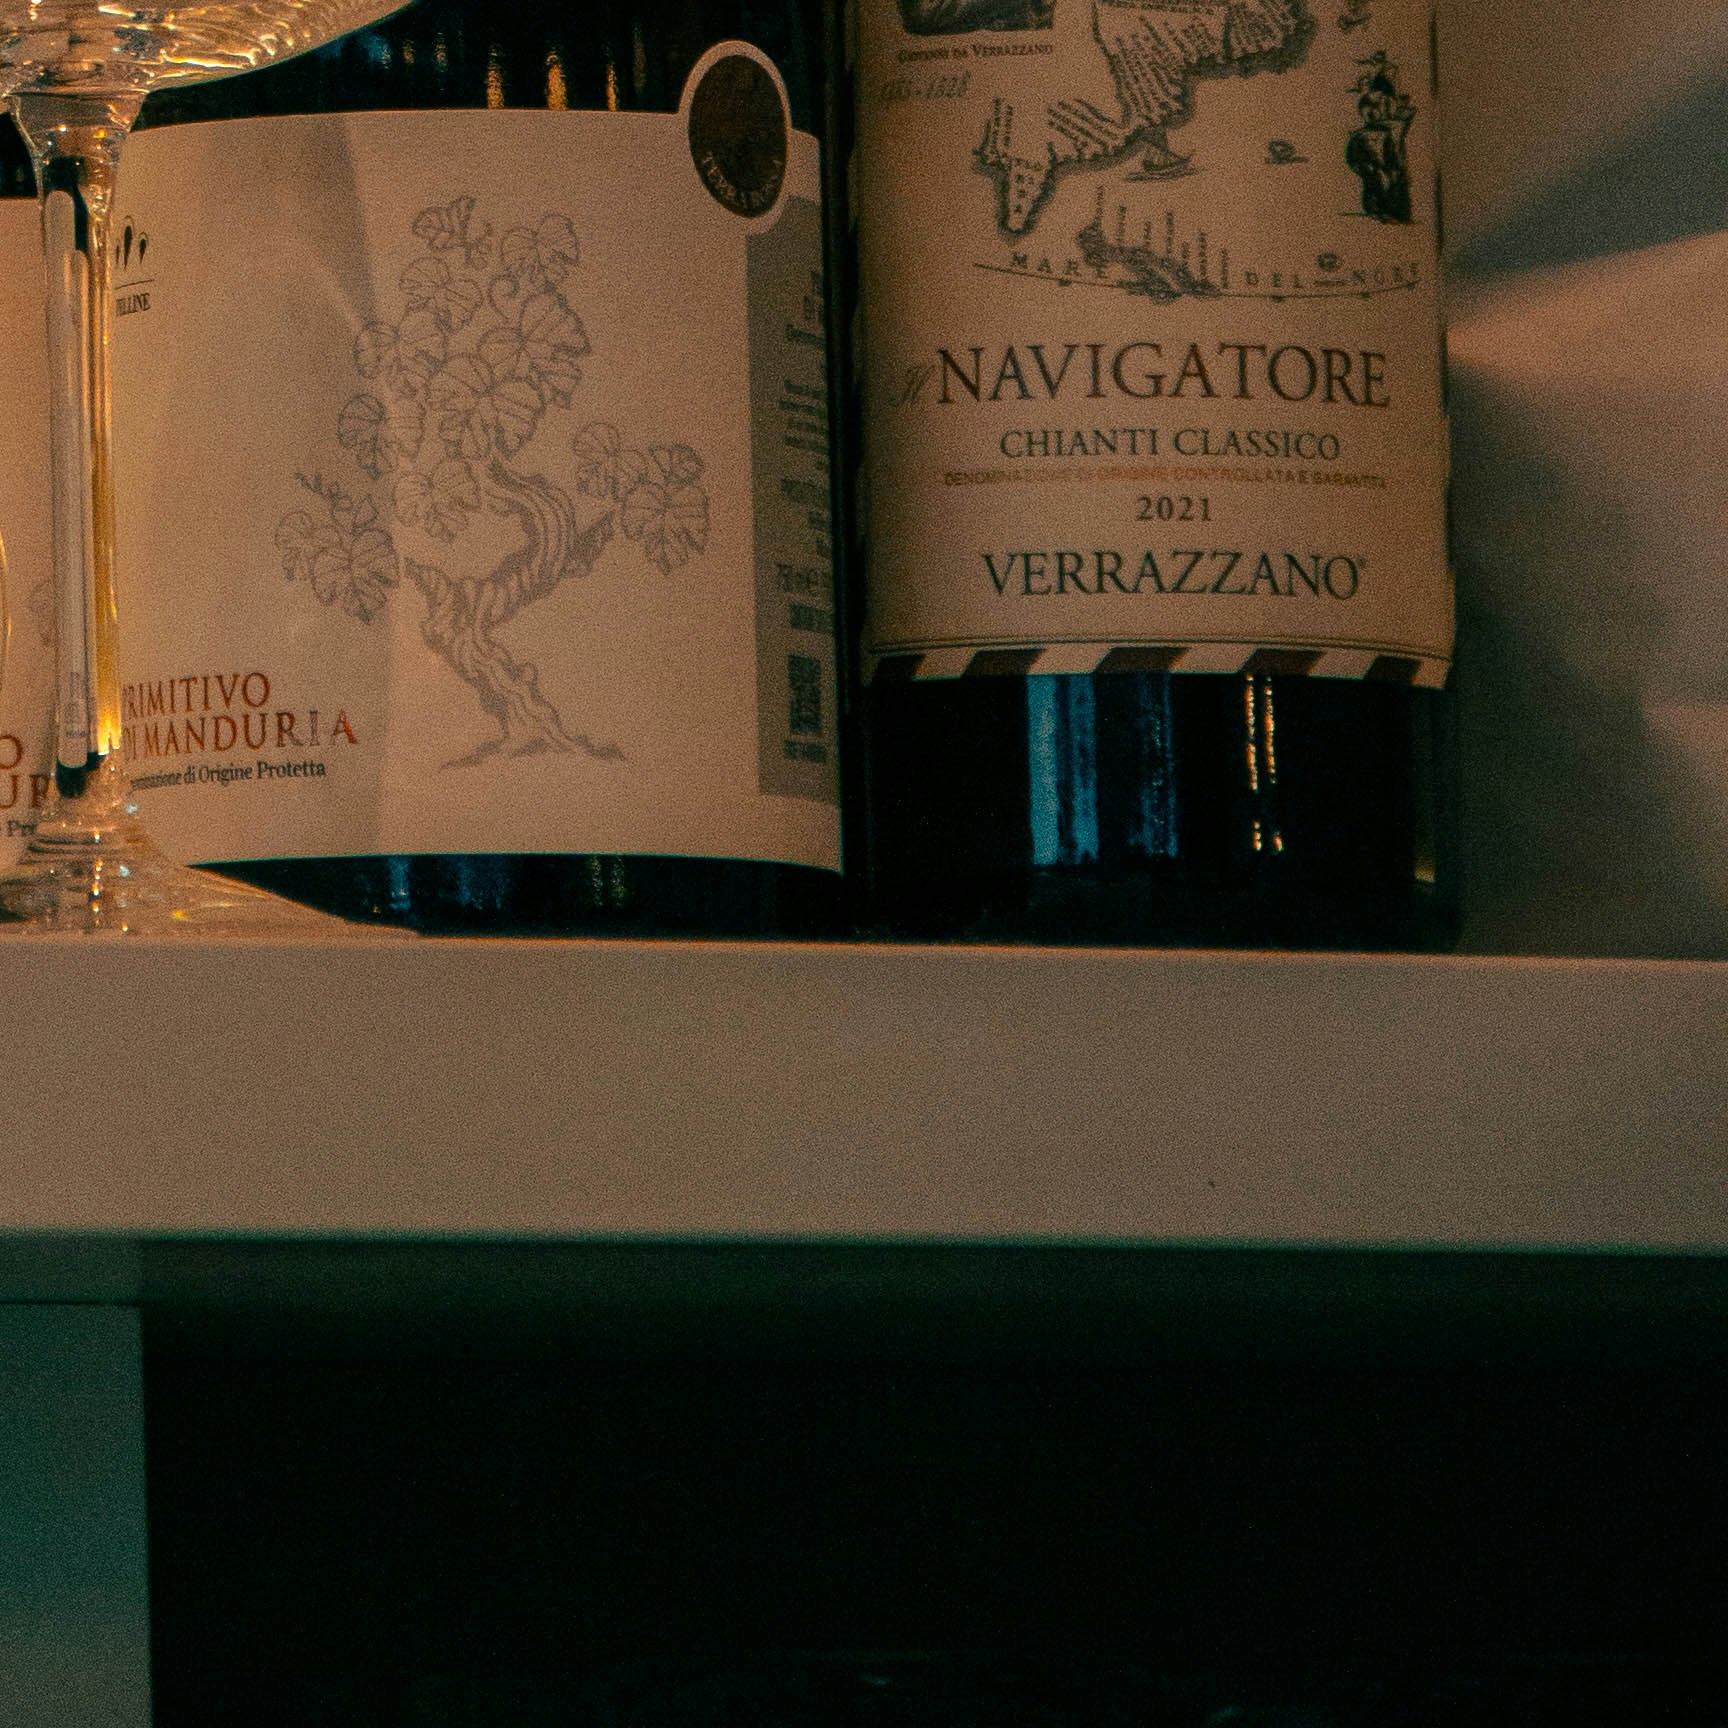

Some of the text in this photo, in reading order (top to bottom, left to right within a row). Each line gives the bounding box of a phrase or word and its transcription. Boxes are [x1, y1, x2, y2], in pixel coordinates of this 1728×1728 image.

[937, 342, 1391, 409] NAVIGATORE
[999, 428, 1341, 462] CHIANTI CLASSICO
[1136, 495, 1213, 523] 2021
[981, 550, 1359, 601] VERRAZZANO
[144, 709, 359, 760] MANDURIA
[198, 763, 253, 788] Origine
[257, 759, 326, 781] Protetta
